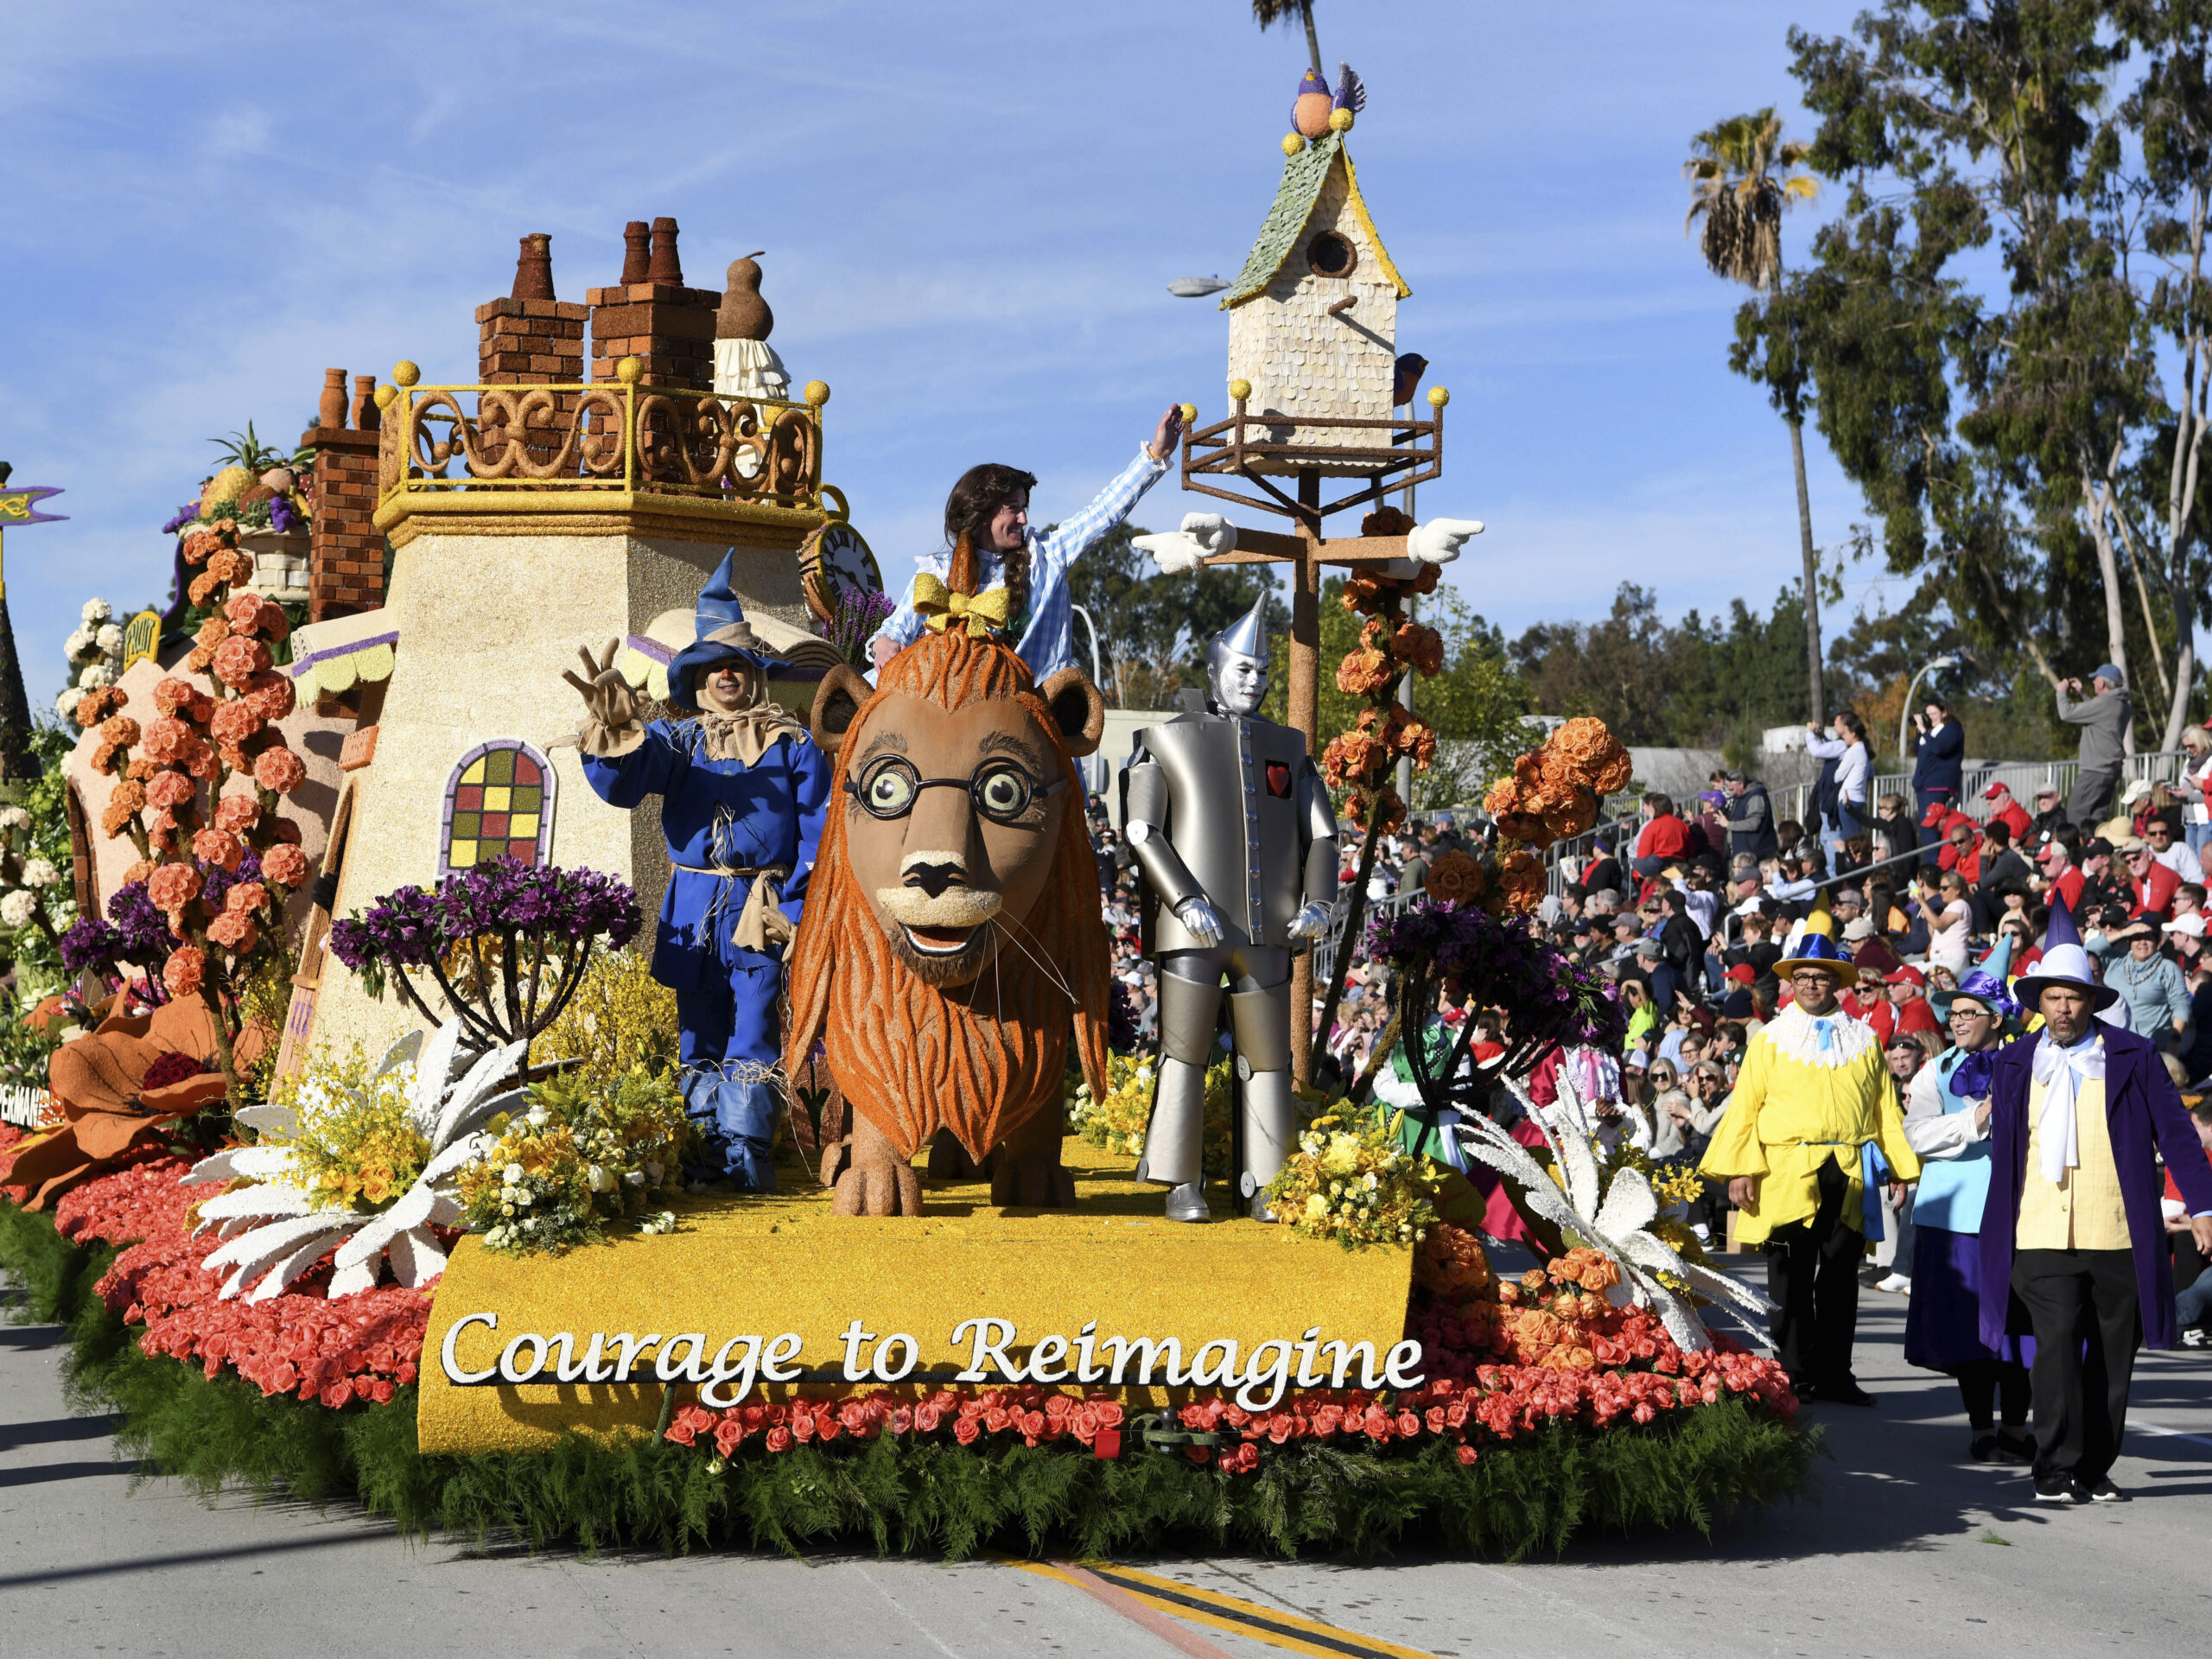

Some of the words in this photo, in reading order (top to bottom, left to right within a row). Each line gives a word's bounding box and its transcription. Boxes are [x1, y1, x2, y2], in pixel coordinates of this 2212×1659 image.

[125, 618, 156, 663] FRUIT
[441, 1312, 804, 1408] Courage
[839, 1319, 919, 1382] to
[950, 1317, 1425, 1412] Reimagine
